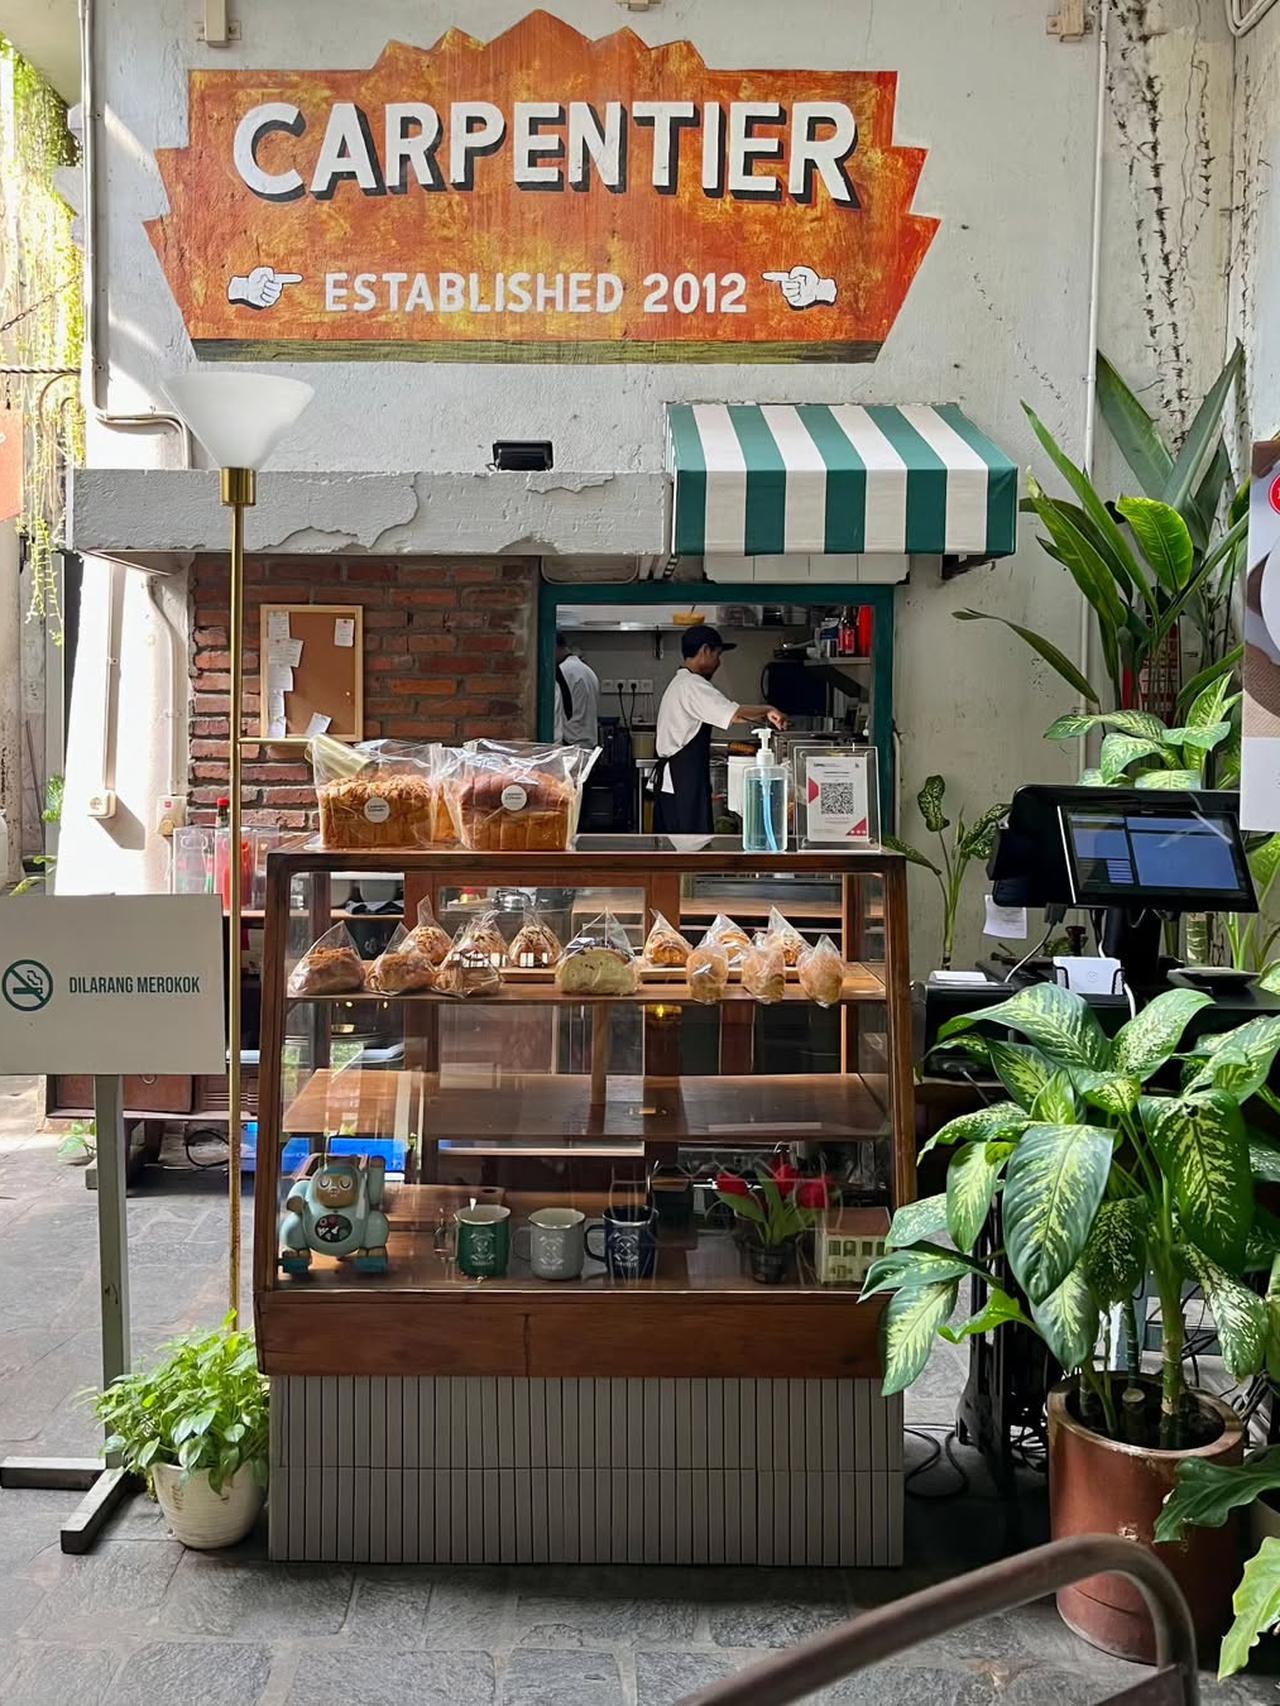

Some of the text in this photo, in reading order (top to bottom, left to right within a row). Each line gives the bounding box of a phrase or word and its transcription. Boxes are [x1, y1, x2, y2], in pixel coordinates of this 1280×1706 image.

[232, 101, 859, 205] CARPENTIER
[324, 272, 748, 314] ESTABLISHED 2012
[69, 976, 200, 994] DILARANG MEROKOK
